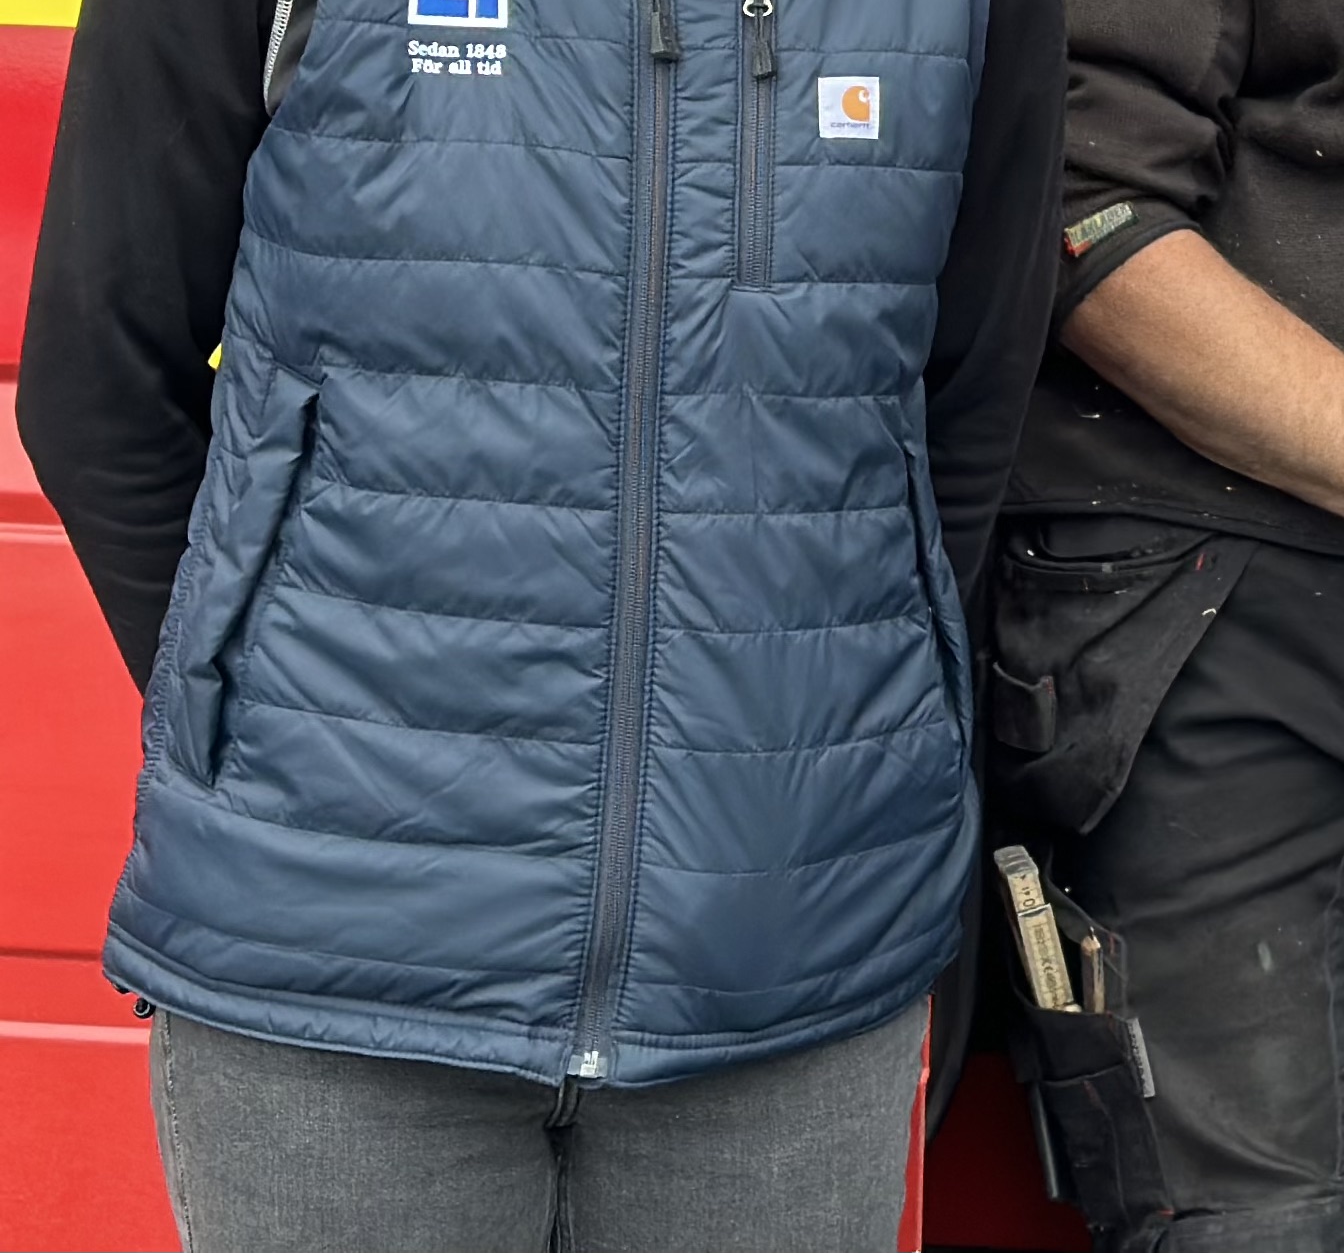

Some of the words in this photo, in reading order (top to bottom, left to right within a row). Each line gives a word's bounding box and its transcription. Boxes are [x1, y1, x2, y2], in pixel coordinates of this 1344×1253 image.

[407, 39, 460, 58] Sedan
[465, 43, 507, 59] 1848
[411, 57, 444, 74] För
[448, 59, 472, 75] all
[476, 60, 502, 75] tid
